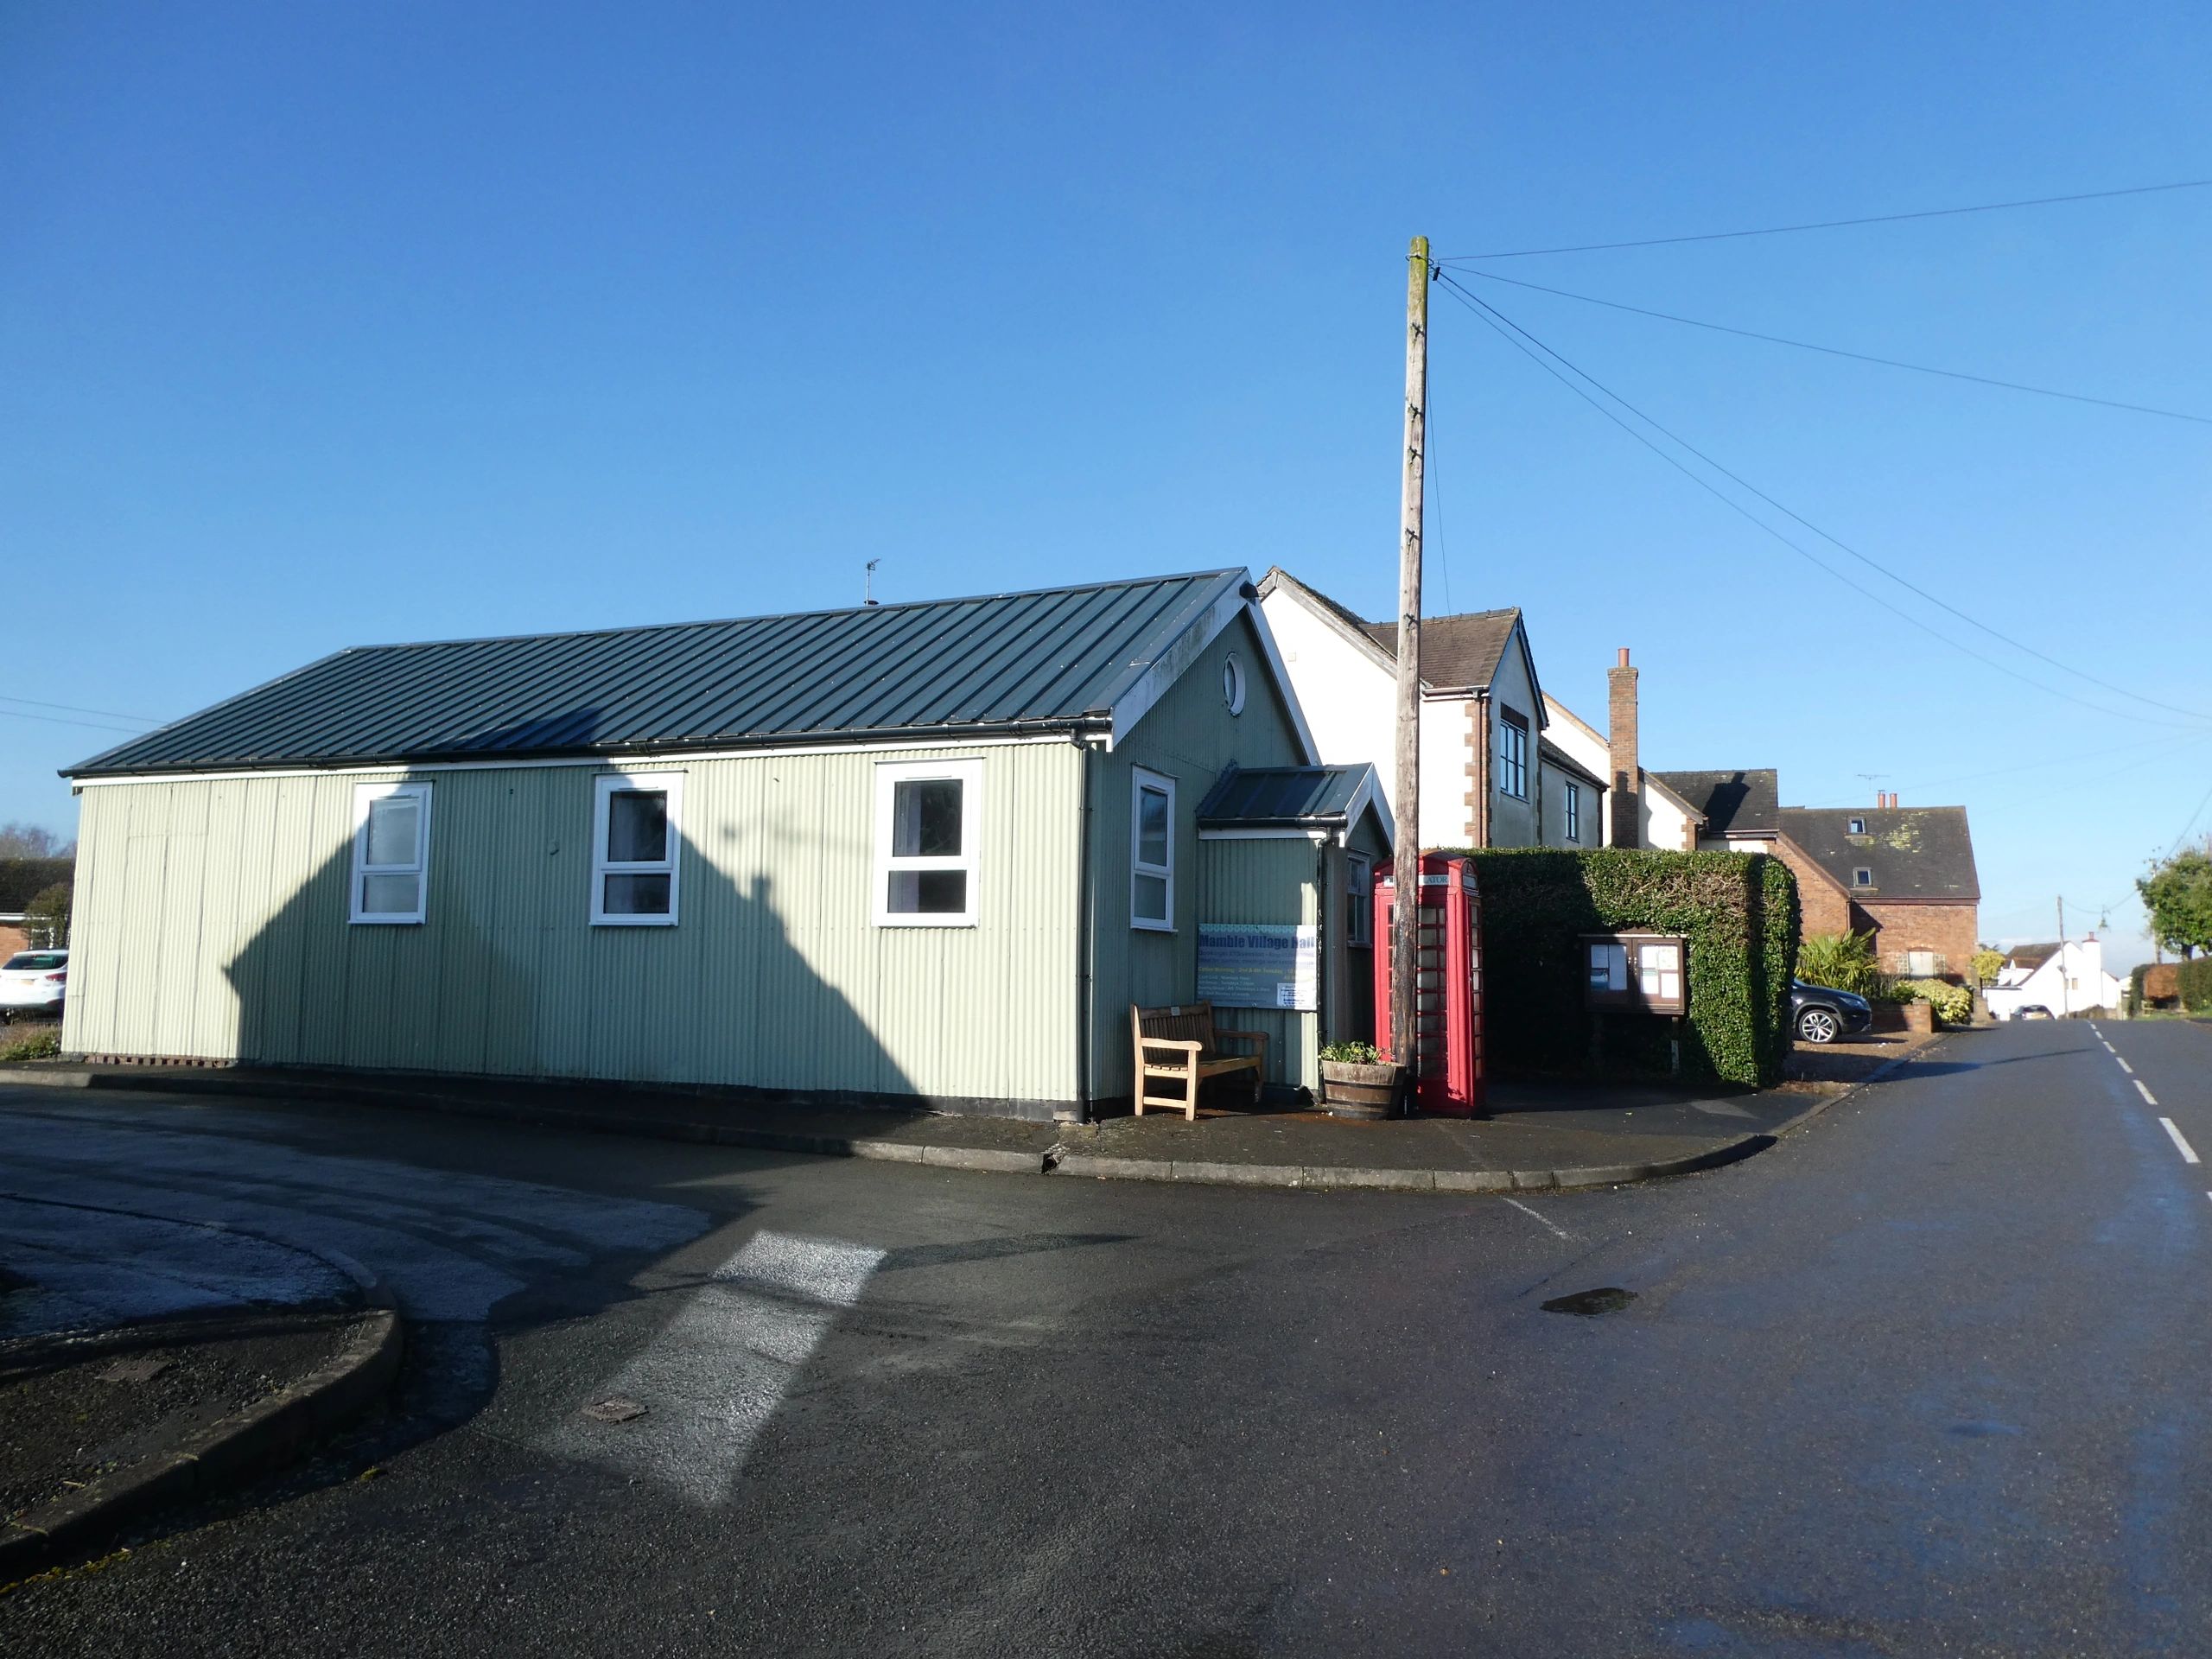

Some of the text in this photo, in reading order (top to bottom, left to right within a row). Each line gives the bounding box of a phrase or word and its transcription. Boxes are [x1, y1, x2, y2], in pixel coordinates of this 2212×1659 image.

[1198, 934, 1315, 950] Mamble Village Hall
